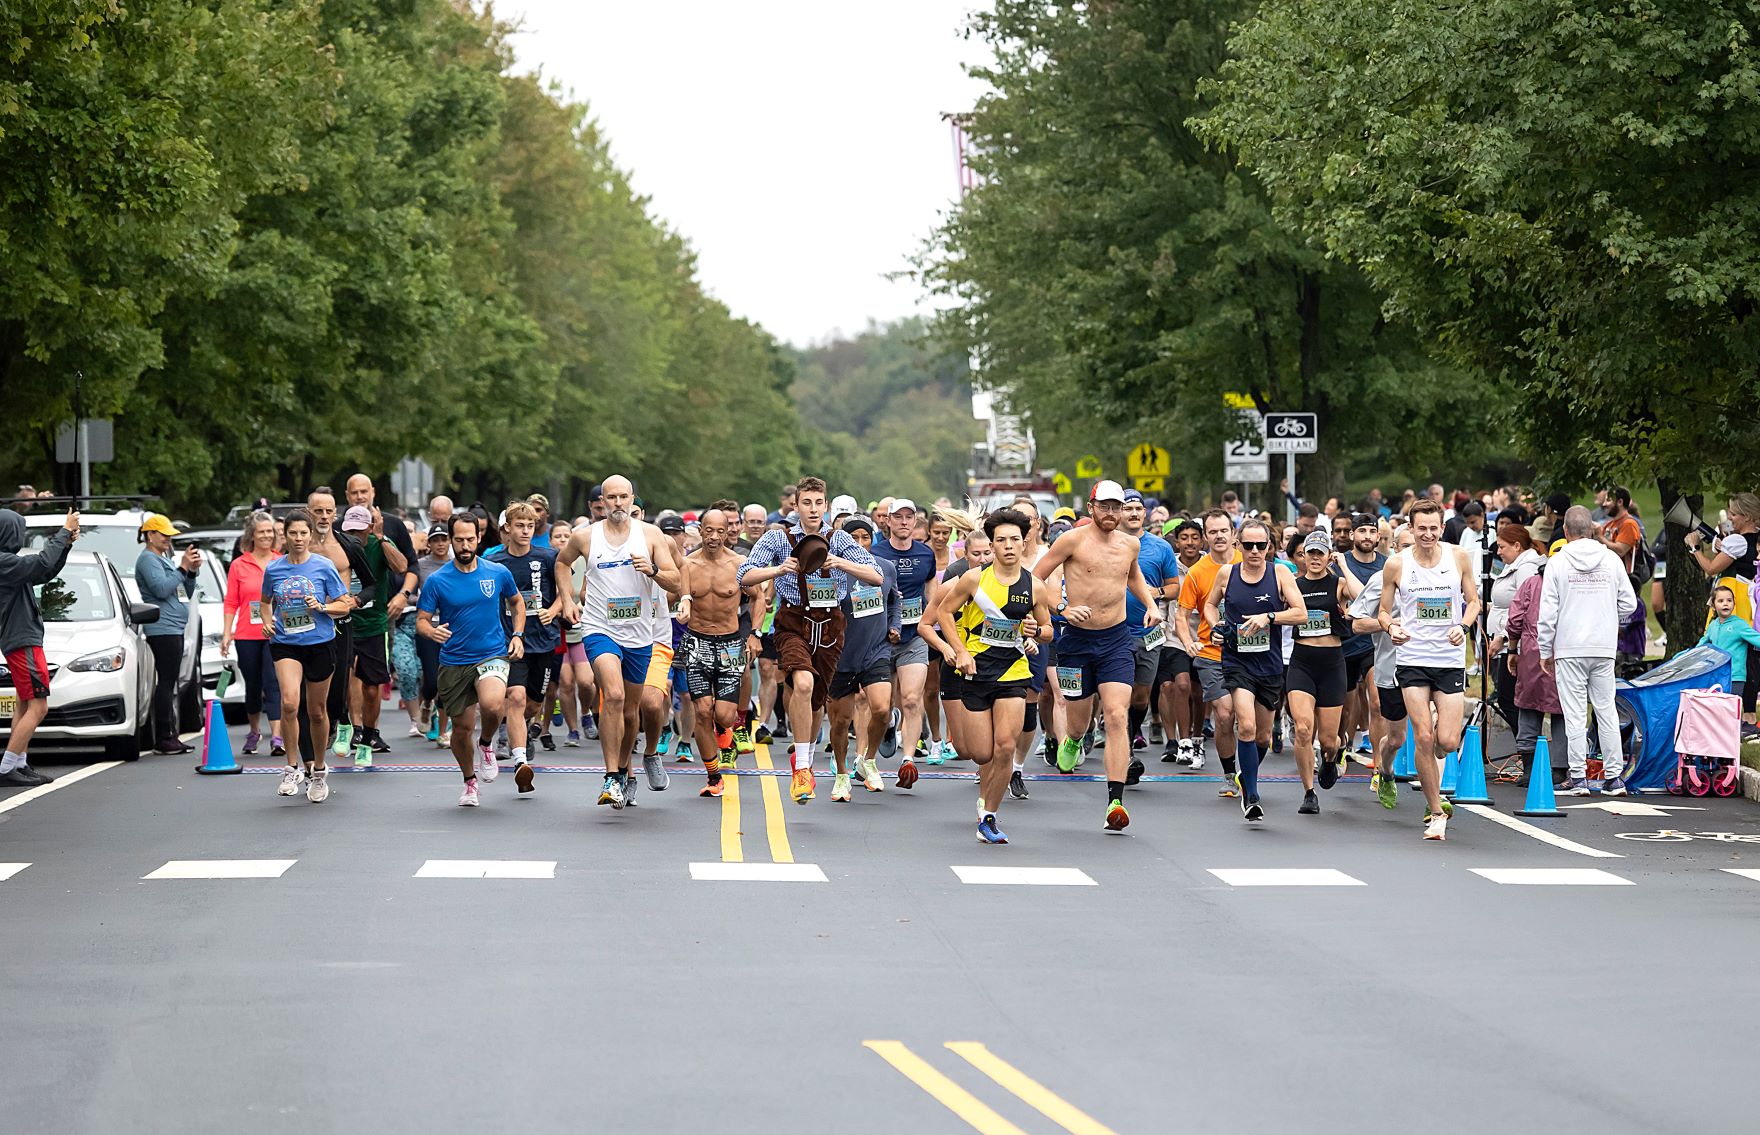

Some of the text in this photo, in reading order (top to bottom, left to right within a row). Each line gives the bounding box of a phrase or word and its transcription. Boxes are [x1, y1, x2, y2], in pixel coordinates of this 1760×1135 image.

[1231, 439, 1264, 456] 25
[1269, 441, 1313, 449] BIKE LANE
[810, 590, 836, 600] 5032
[1011, 595, 1029, 604] GSTC
[856, 597, 880, 610] 5100
[612, 607, 638, 618] 3033
[1421, 608, 1448, 618] 3014
[285, 615, 310, 627] 5173
[986, 627, 1014, 640] 5074
[1241, 634, 1267, 645] 3015
[481, 665, 506, 673] 3017
